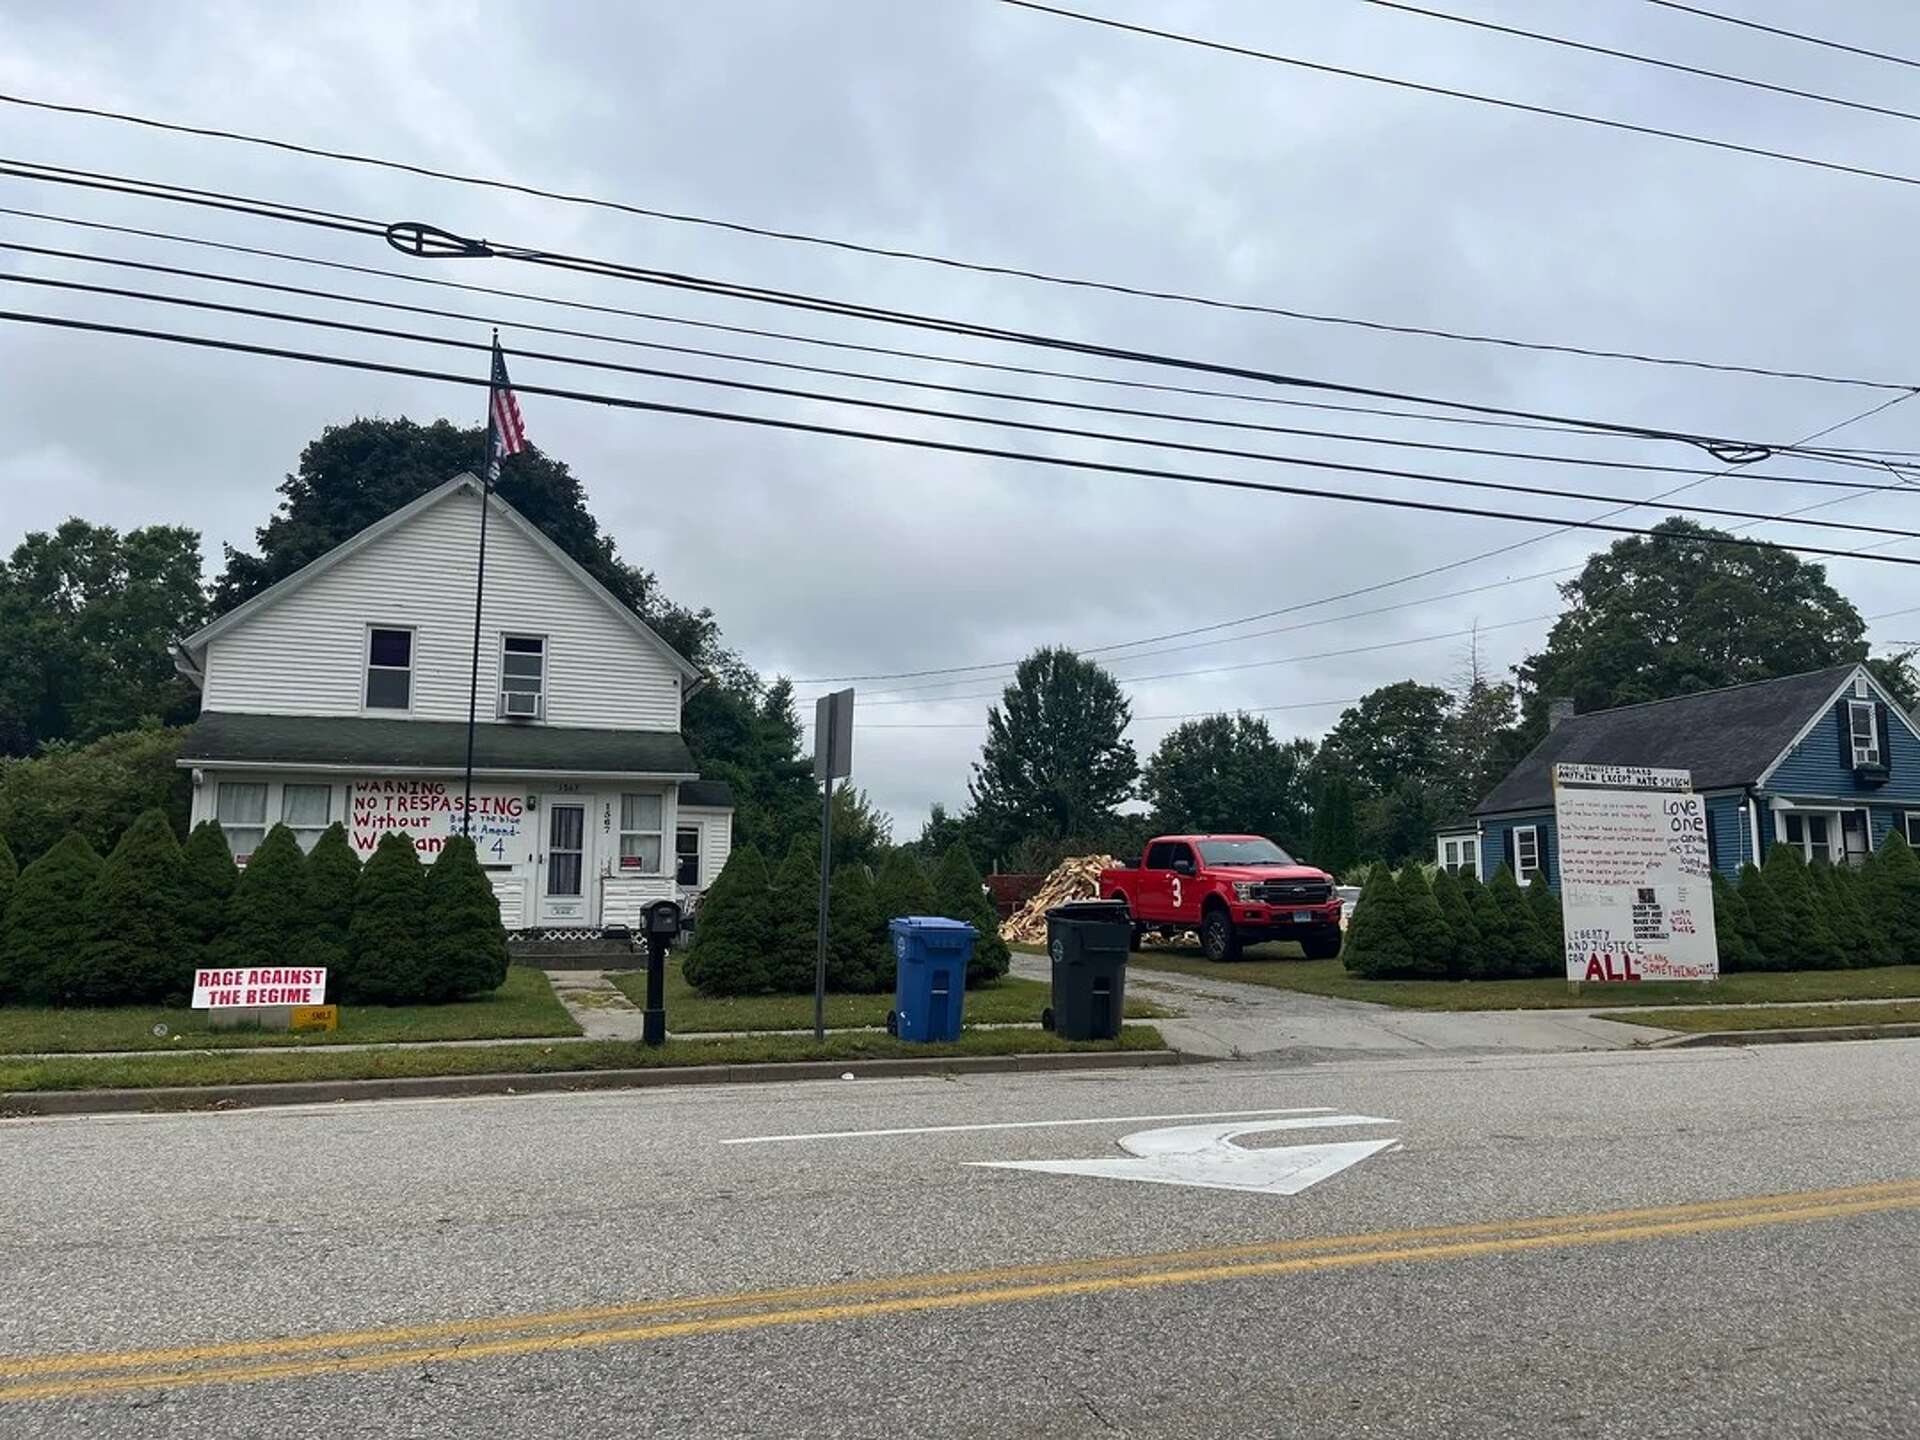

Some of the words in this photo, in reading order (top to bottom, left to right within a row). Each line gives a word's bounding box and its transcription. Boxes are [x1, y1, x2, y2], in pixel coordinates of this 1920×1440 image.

[356, 781, 445, 795] WARNING
[355, 797, 377, 810] NO
[384, 796, 523, 816] TRESPASSING
[354, 811, 430, 829] Without
[490, 838, 505, 860] 4
[1172, 878, 1182, 907] 3
[1568, 929, 1609, 940] LIBERTY
[1568, 941, 1588, 951] AND
[1591, 941, 1644, 954] JUSTICE
[1568, 953, 1586, 963] FOR
[1585, 952, 1641, 980] ALL
[1642, 963, 1699, 977] SOMETHING
[198, 970, 244, 987] RAGE
[248, 970, 324, 985] AGAINST
[209, 990, 241, 1005] THE
